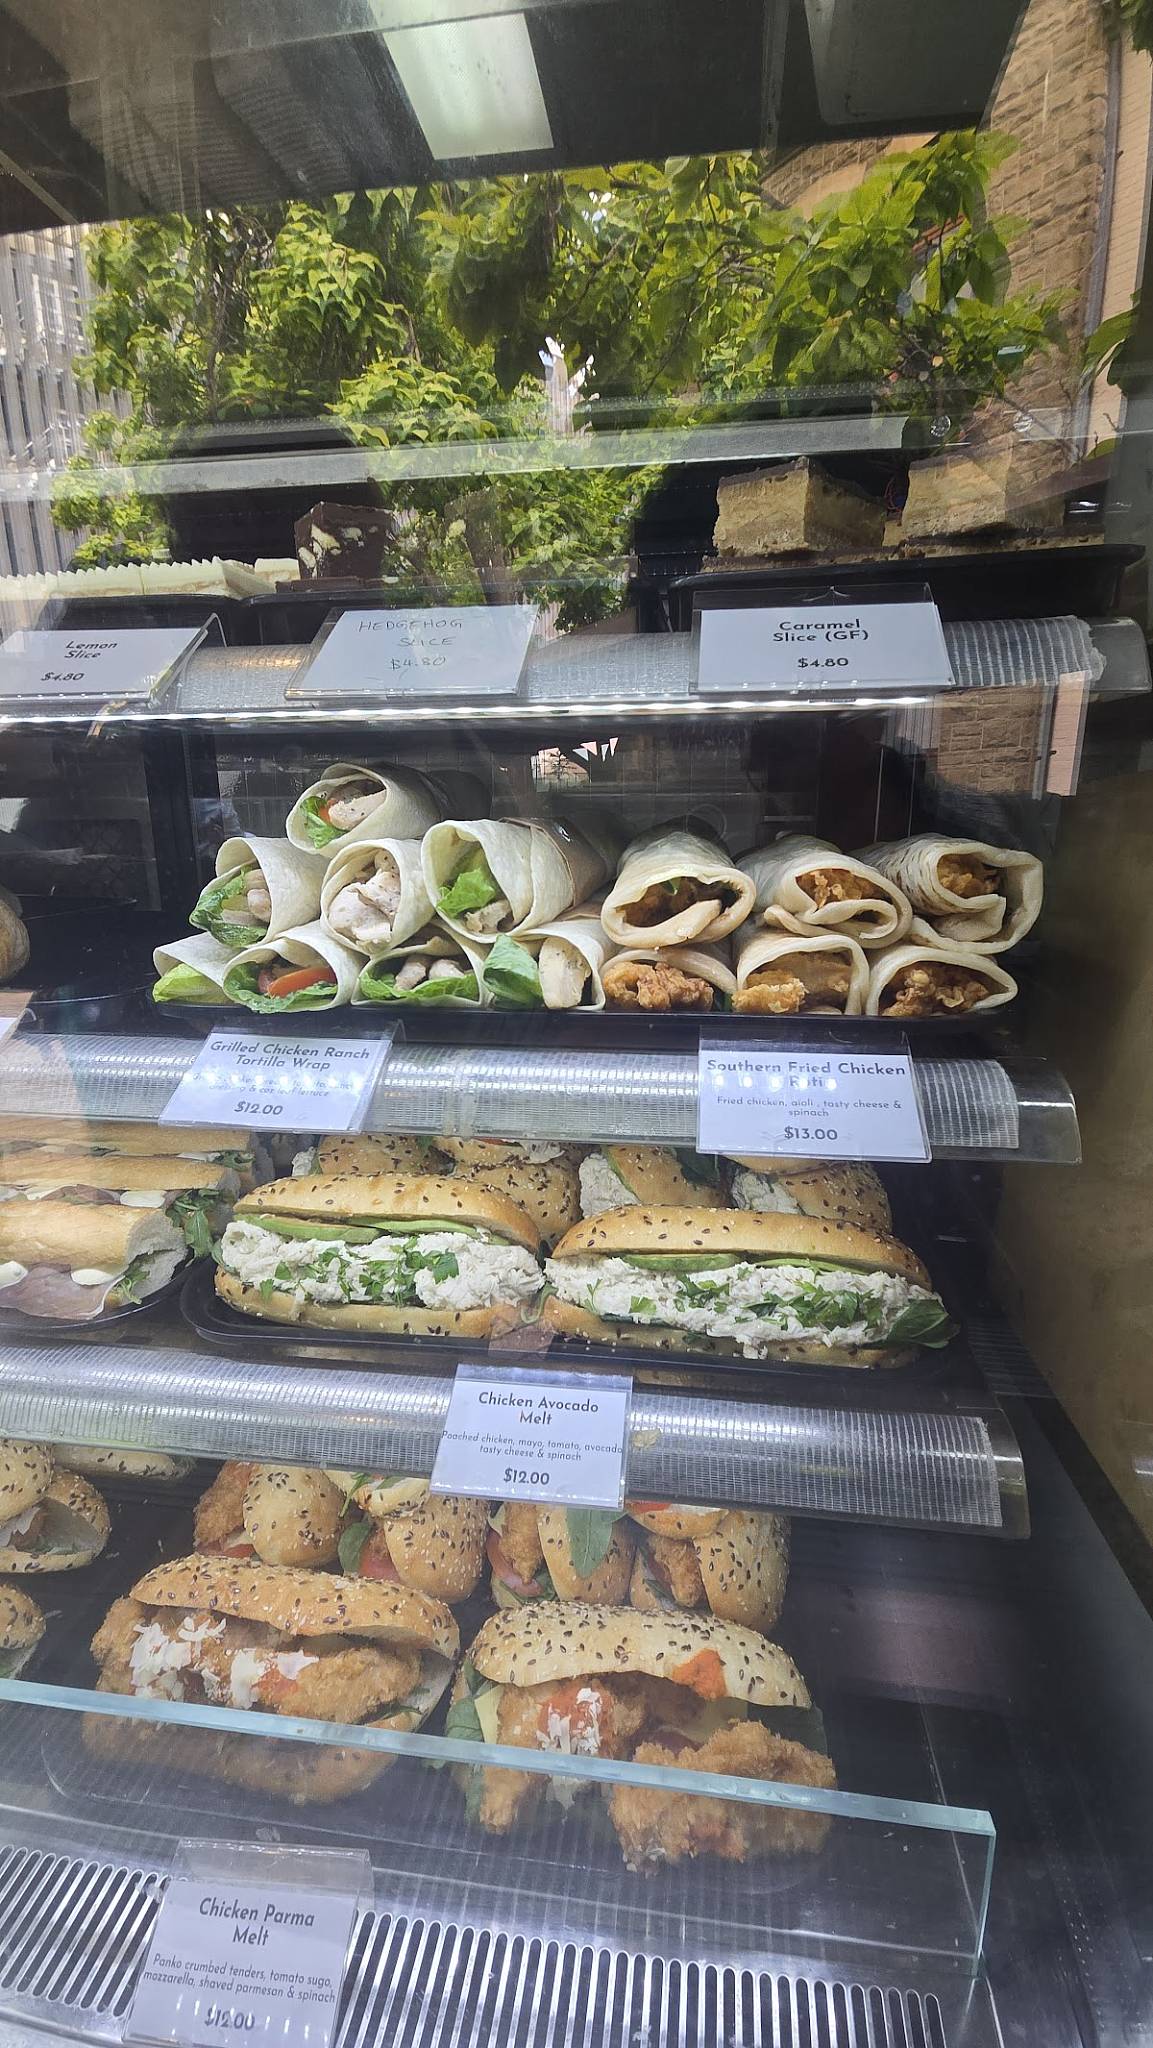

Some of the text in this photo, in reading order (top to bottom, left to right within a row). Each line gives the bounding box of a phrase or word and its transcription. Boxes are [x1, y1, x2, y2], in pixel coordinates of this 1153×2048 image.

[358, 618, 463, 632] HEDGEHOG
[779, 618, 860, 631] Caramel
[398, 636, 456, 647] SLICE
[772, 629, 869, 642] Slice (GF)
[65, 640, 118, 650] Lemon
[64, 649, 102, 659] Slice
[389, 656, 446, 671] $4.80
[797, 657, 849, 669] $4.80
[40, 671, 85, 681] $4.80
[210, 1041, 370, 1060] Grilled Chicken Ranch
[235, 1055, 331, 1072] Tortilla Wrap
[707, 1059, 906, 1076] Southern Fried Chicken
[789, 1075, 824, 1088] Rti
[233, 1100, 284, 1116] $12.00
[717, 1096, 743, 1105] Fried
[747, 1096, 788, 1107] chicken,
[823, 1100, 850, 1110] tasty
[853, 1101, 890, 1110] cheese
[893, 1101, 902, 1109] &
[788, 1108, 829, 1118] spinach
[784, 1126, 838, 1141] $13.00
[478, 1391, 599, 1413] Chicken Avocado
[519, 1411, 553, 1425] Melt
[442, 1430, 480, 1442] Poached
[481, 1433, 515, 1446] chicken,
[518, 1439, 545, 1449] mayo,
[548, 1440, 582, 1451] tomato,
[479, 1445, 582, 1461] tasty cheese & spinach
[503, 1467, 551, 1486] $12.00
[199, 1897, 315, 1927] Chicken Parma
[232, 1925, 269, 1946] Melt
[153, 1953, 333, 1990] Panko crumbed tenders, tomato sugo,
[143, 1971, 336, 2004] mozzarella, shaved parmesan & spinach
